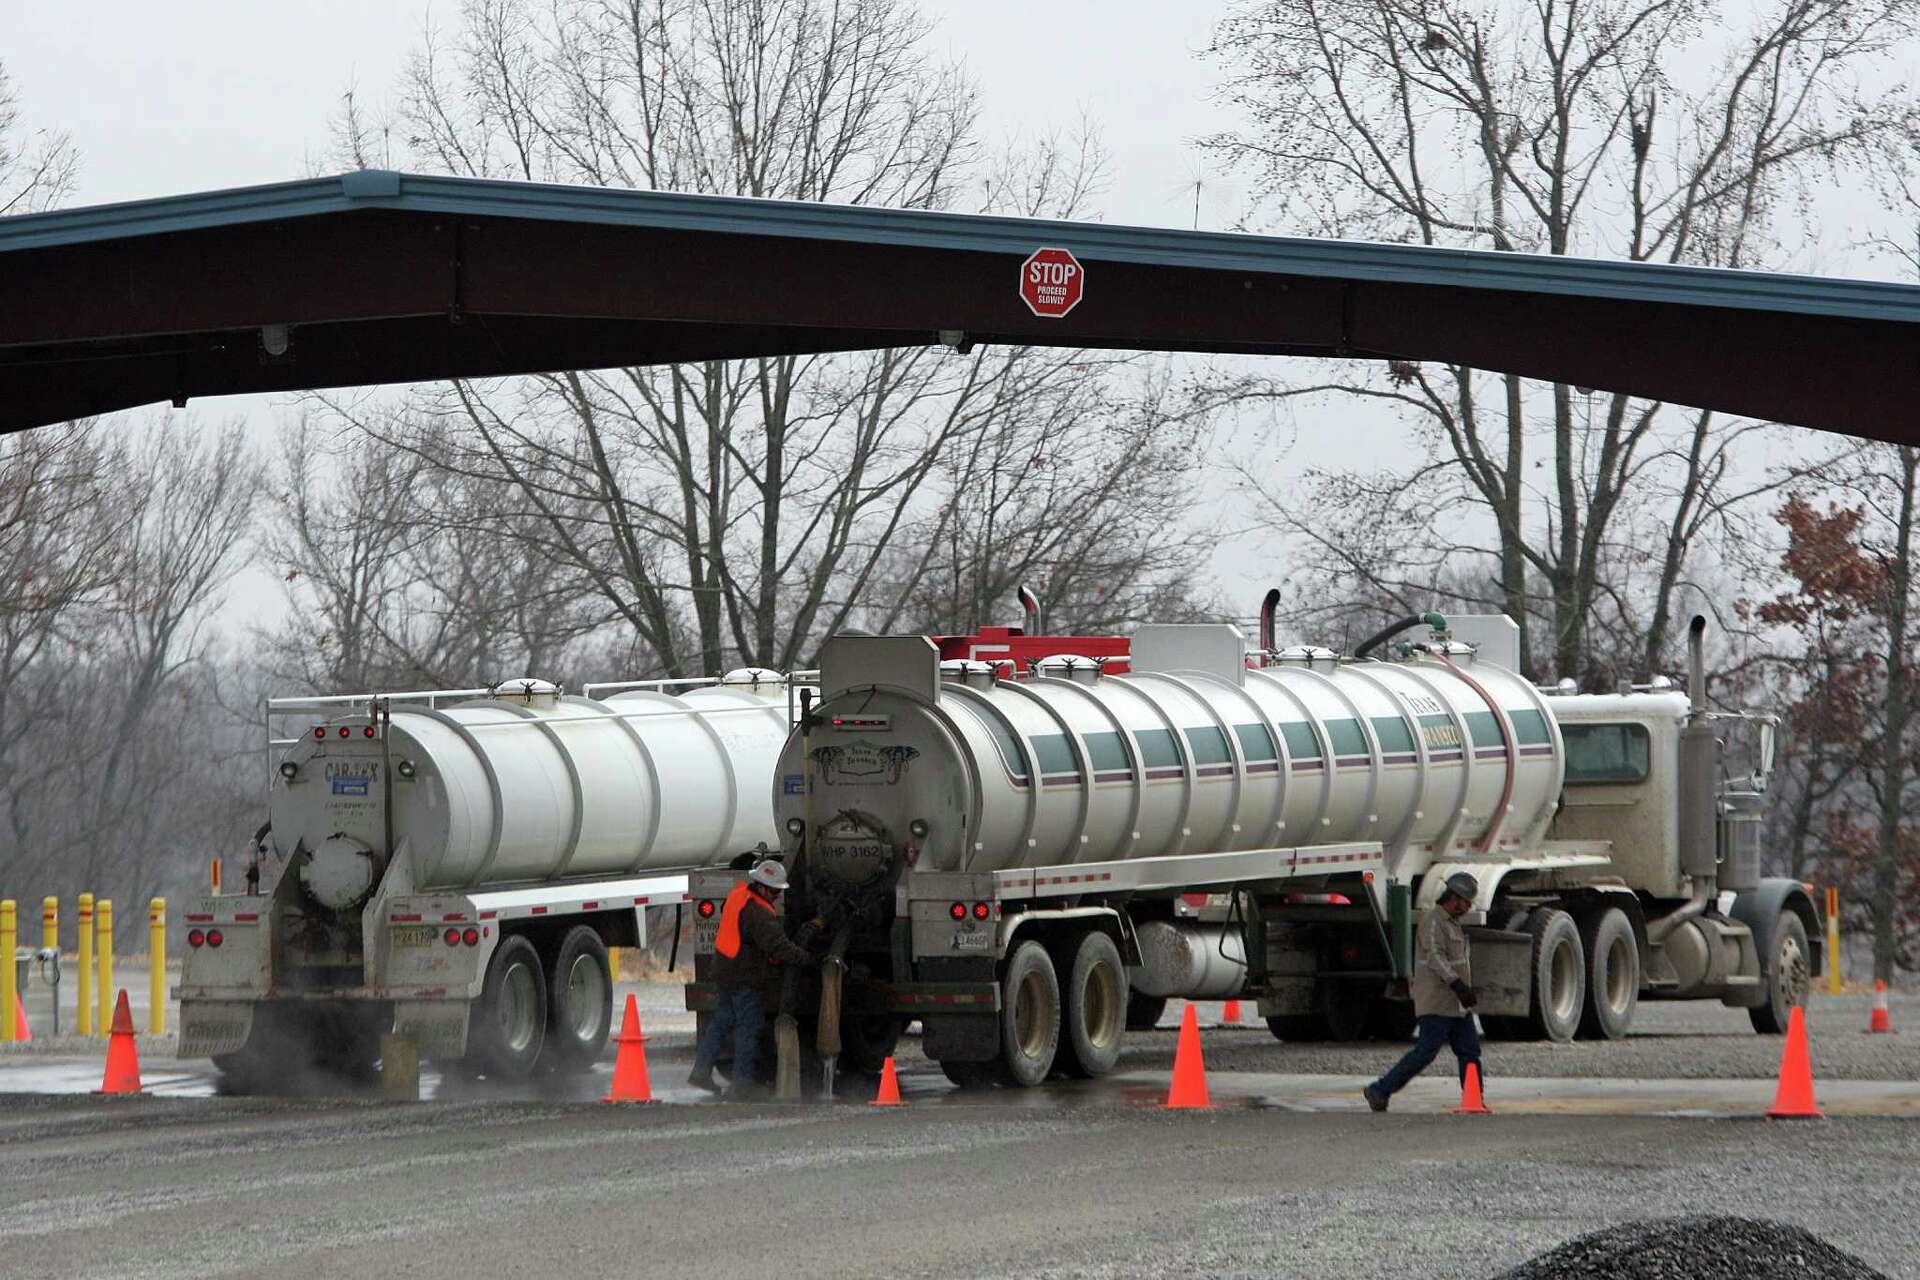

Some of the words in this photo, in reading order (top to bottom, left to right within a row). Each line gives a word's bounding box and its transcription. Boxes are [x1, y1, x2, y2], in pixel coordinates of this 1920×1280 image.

[1030, 262, 1076, 285] STOP
[1037, 286, 1067, 296] PROCEED
[1038, 295, 1065, 305] SLOWLY
[850, 846, 879, 858] 3162
